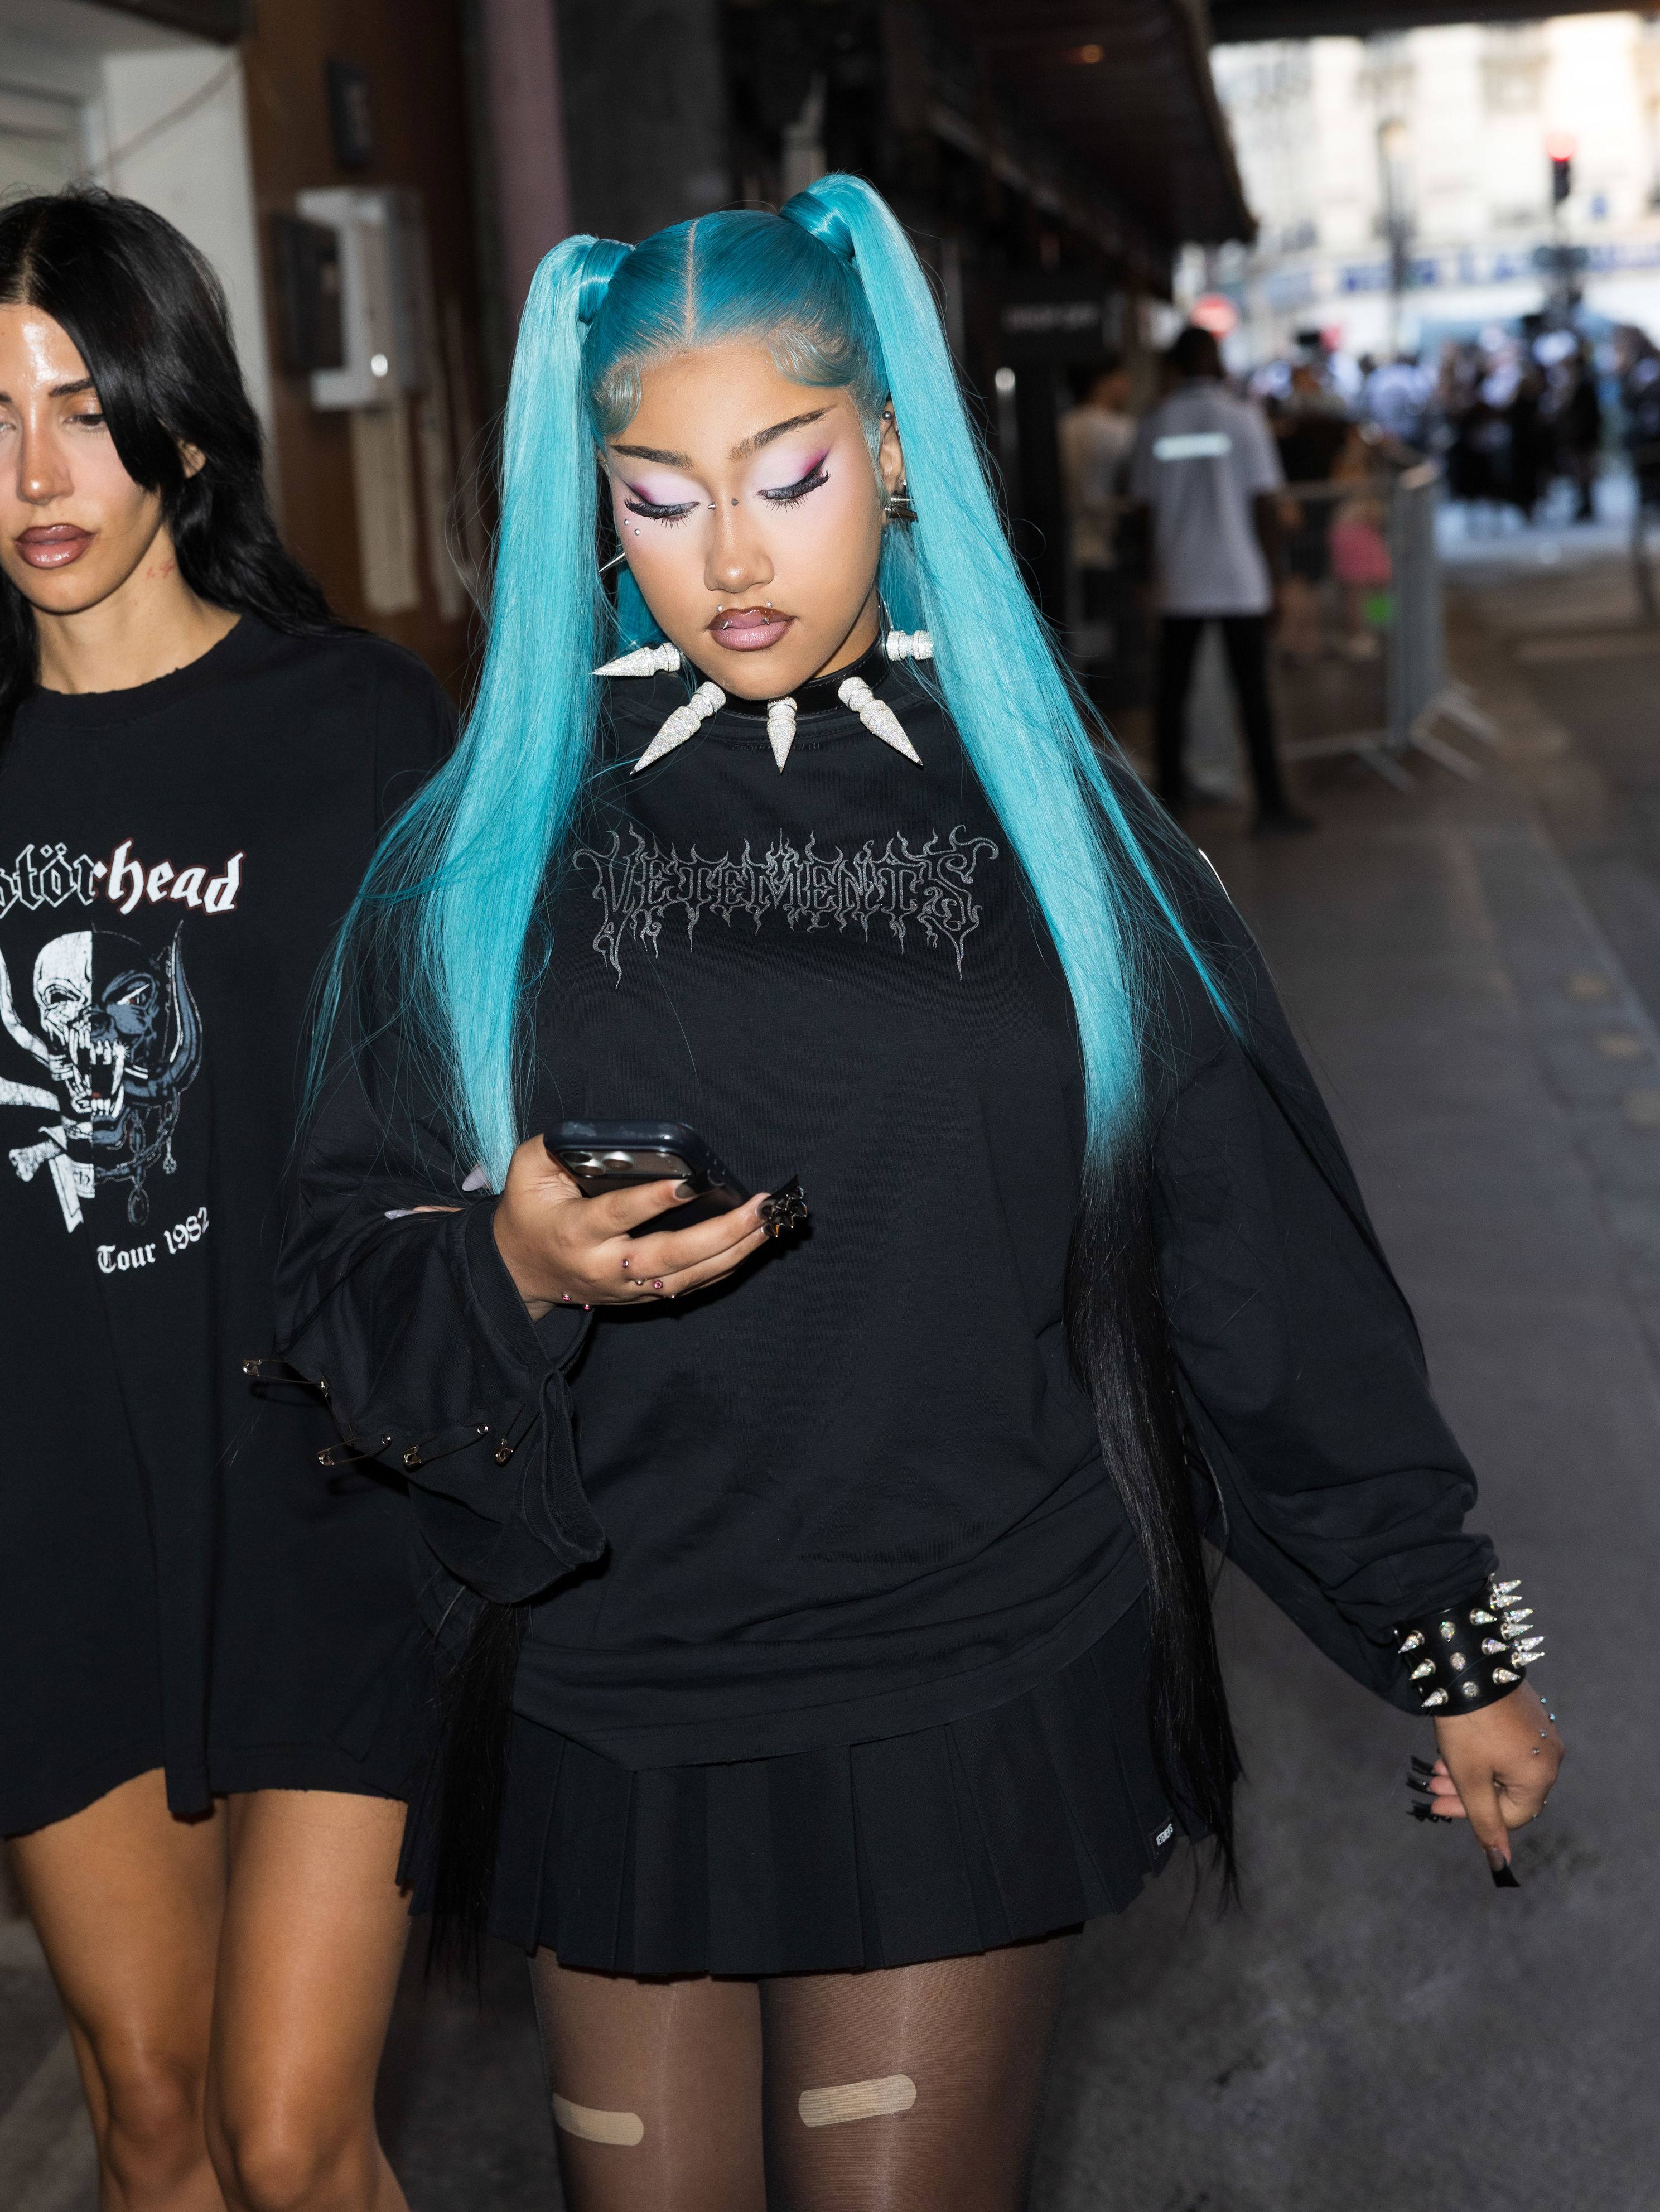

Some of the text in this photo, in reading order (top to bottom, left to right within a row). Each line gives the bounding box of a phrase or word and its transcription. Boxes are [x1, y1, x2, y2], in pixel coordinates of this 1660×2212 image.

[572, 821, 999, 990] VETEMENTS
[96, 1206, 210, 1274] Tour 1982
